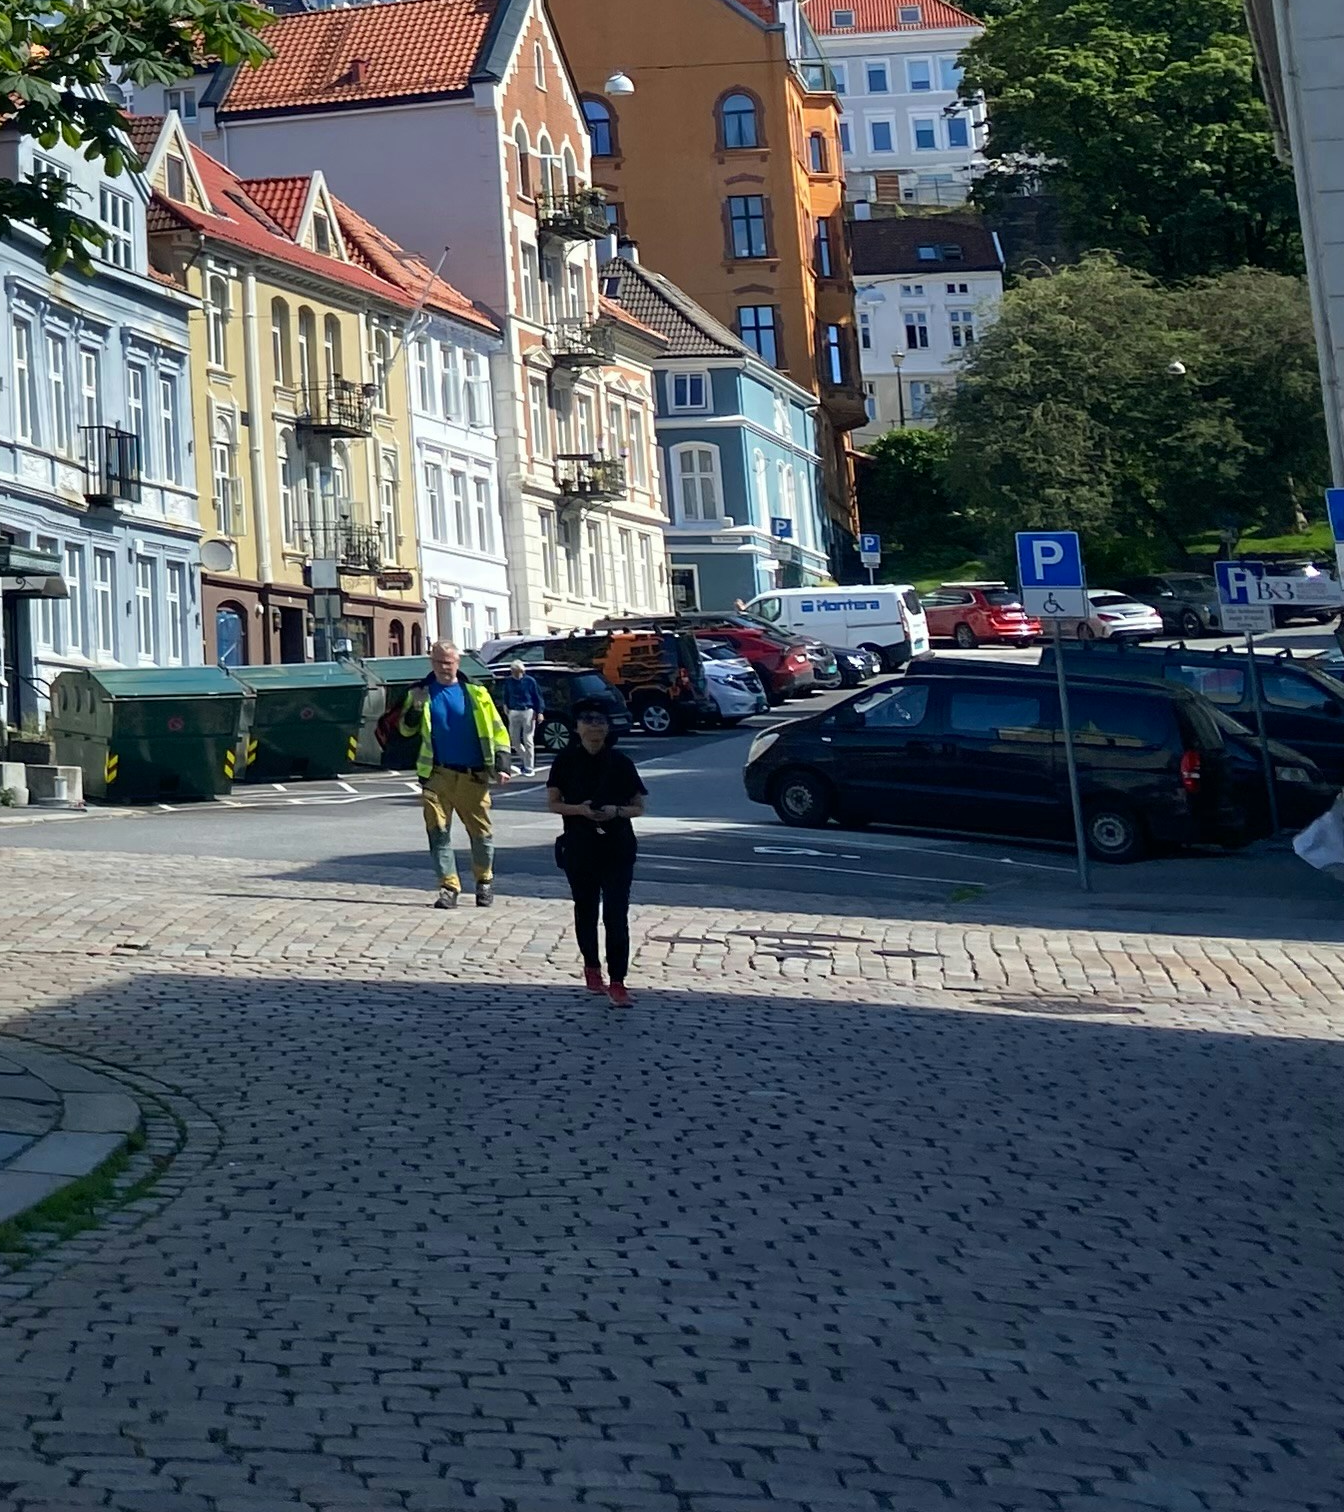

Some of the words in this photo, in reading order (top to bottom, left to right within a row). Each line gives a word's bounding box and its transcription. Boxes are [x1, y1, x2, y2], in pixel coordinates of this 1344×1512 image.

[776, 520, 787, 535] P
[865, 537, 874, 551] P
[1032, 540, 1064, 580] P
